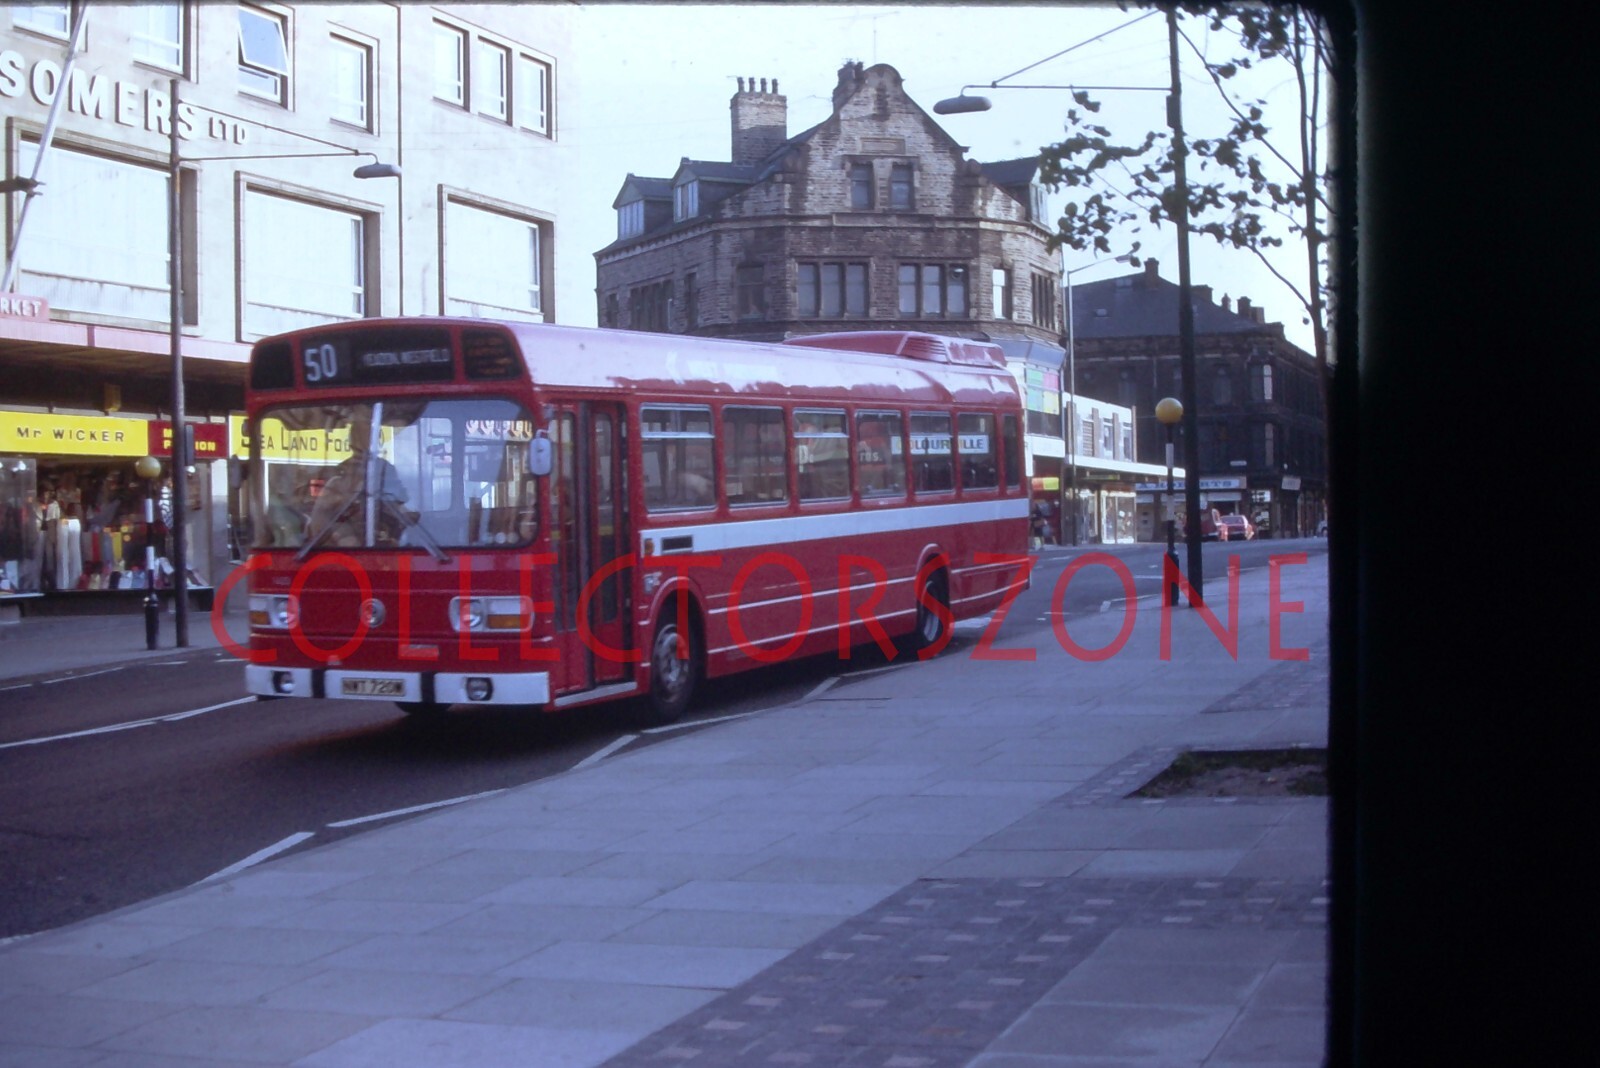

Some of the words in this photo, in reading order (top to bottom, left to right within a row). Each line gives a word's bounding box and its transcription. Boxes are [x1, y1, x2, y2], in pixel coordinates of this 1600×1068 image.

[0, 50, 196, 140] SOMERS
[208, 116, 247, 144] LTD
[304, 343, 338, 382] 50
[16, 425, 42, 440] Mr
[52, 428, 125, 443] WICKER
[163, 439, 216, 452] FION
[281, 426, 318, 452] LAND
